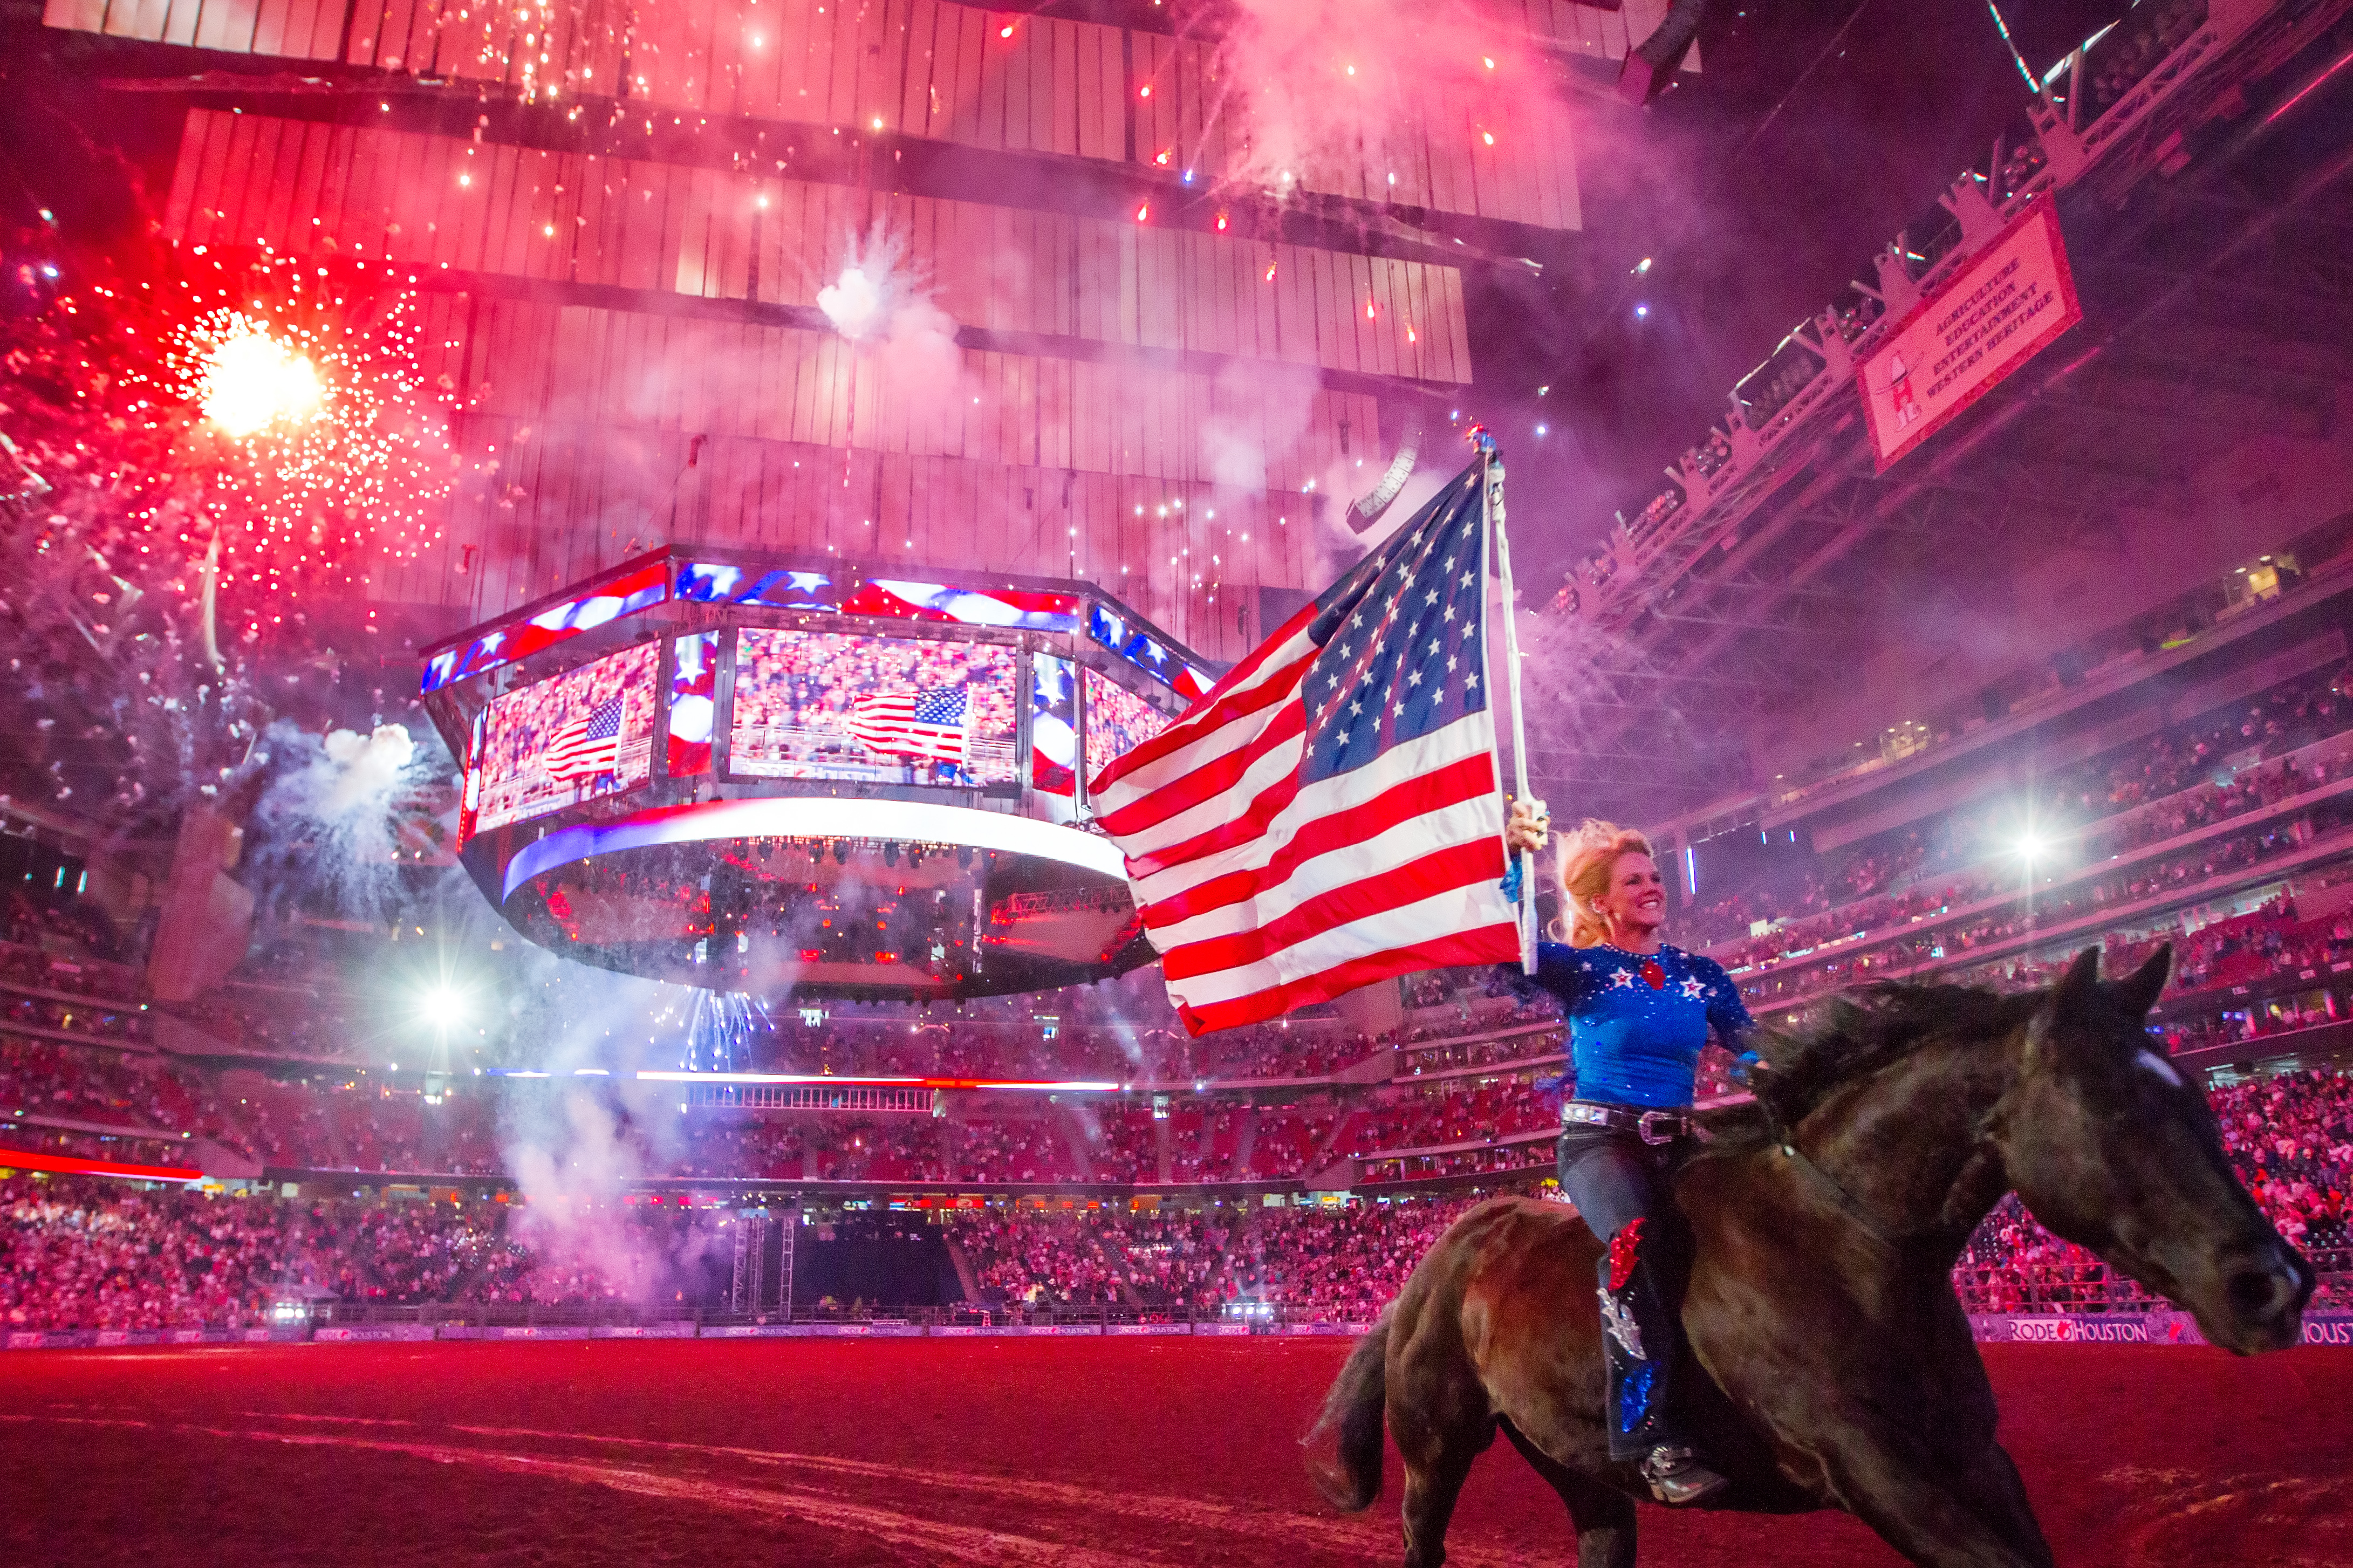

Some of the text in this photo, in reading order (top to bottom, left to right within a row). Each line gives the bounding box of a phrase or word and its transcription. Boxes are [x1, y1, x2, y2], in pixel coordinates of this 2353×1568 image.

[1933, 282, 2037, 376] ENTERTAINMENT
[1935, 256, 2021, 336] AGRICULTURE
[1945, 281, 2016, 346] EDUCATION
[1926, 290, 2054, 398] WESTERN HERITAGE
[2074, 1319, 2148, 1341] HOUSTON
[2301, 1320, 2353, 1344] OUS
